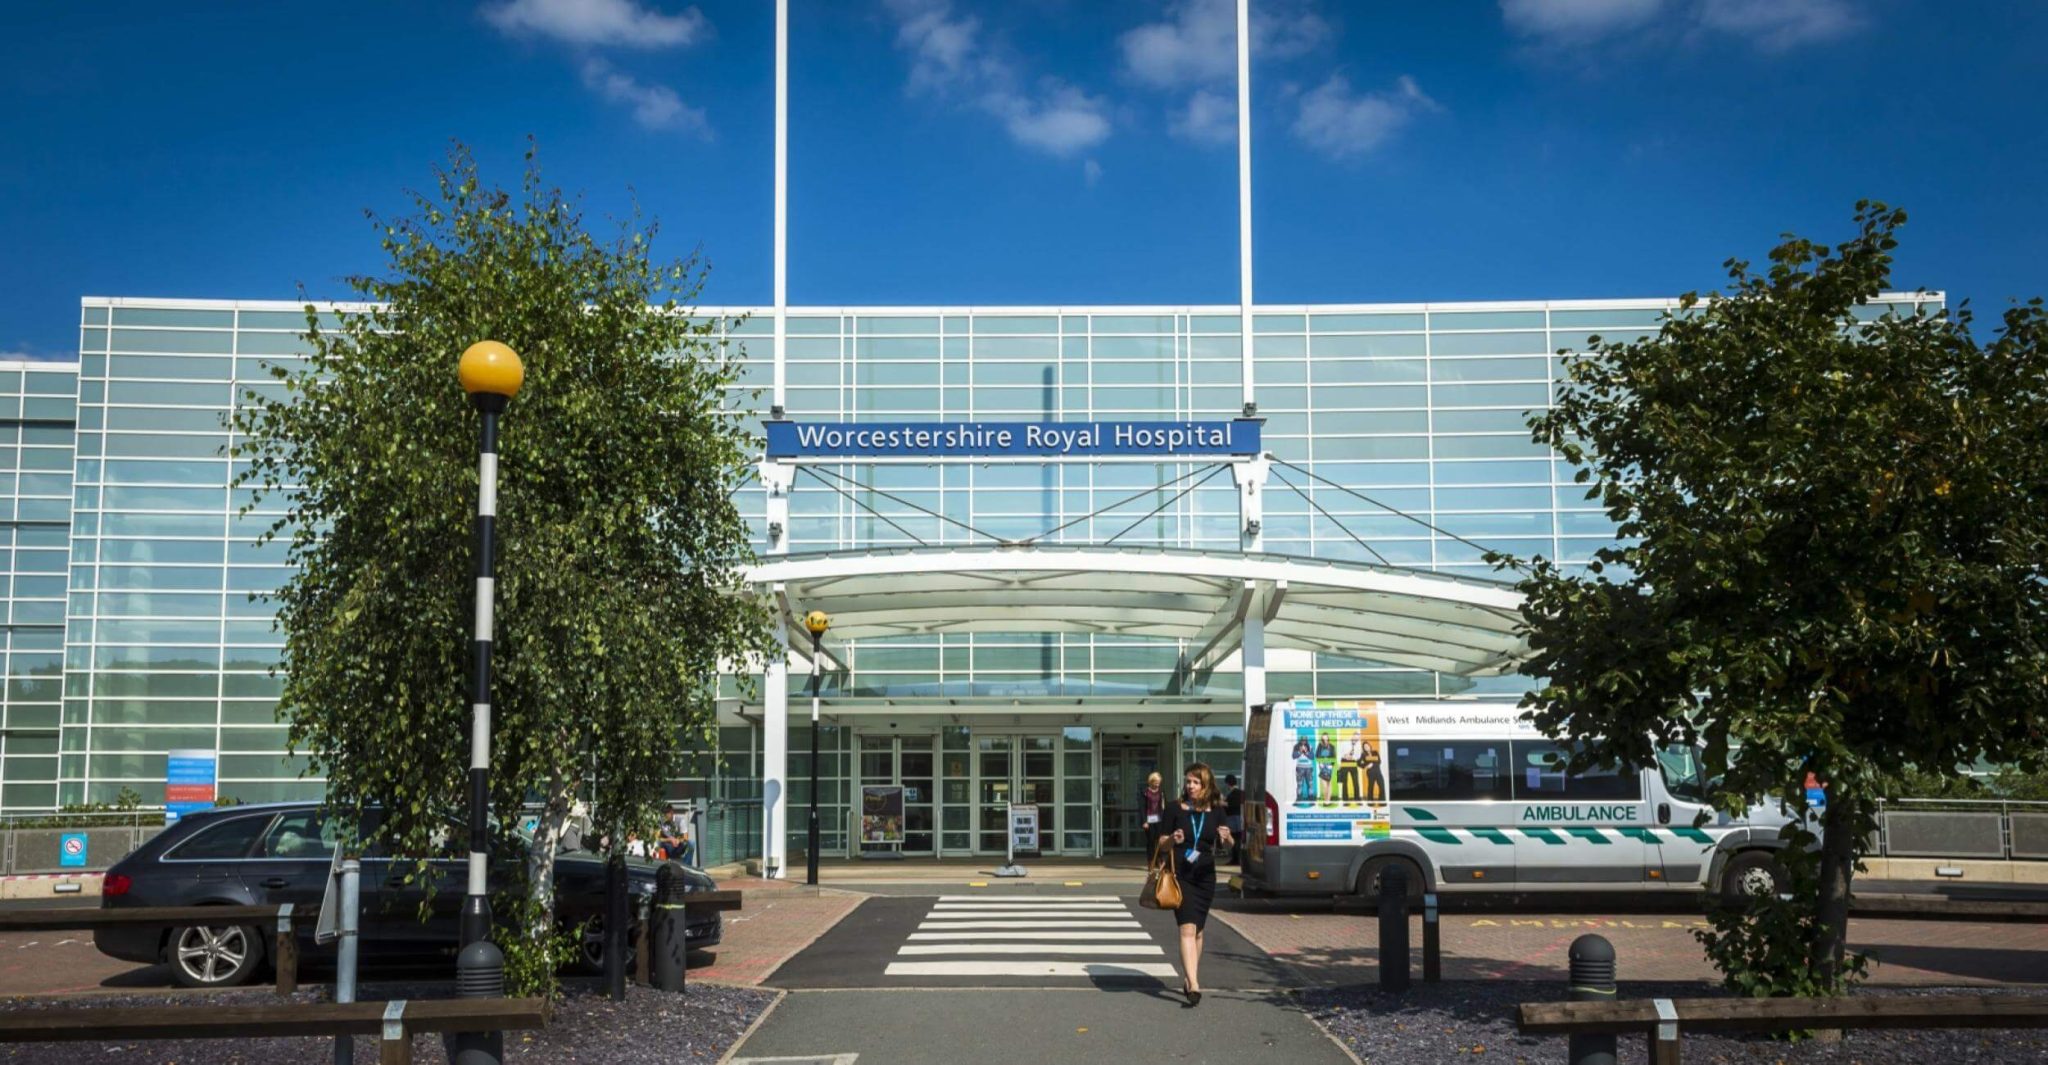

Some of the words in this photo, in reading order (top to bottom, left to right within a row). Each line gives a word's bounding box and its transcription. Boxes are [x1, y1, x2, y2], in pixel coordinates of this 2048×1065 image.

[797, 425, 1012, 448] Worcestershire
[1026, 424, 1100, 452] Royal
[1115, 423, 1232, 451] Hospital
[1290, 711, 1312, 719] NONE
[1327, 711, 1353, 719] THESE
[1387, 715, 1409, 724] West
[1416, 715, 1456, 724] Midlands
[1459, 715, 1510, 724] Ambulance
[1290, 719, 1319, 728] PEOPLE
[1322, 719, 1343, 728] NEED
[1523, 806, 1637, 821] AMBULANCE
